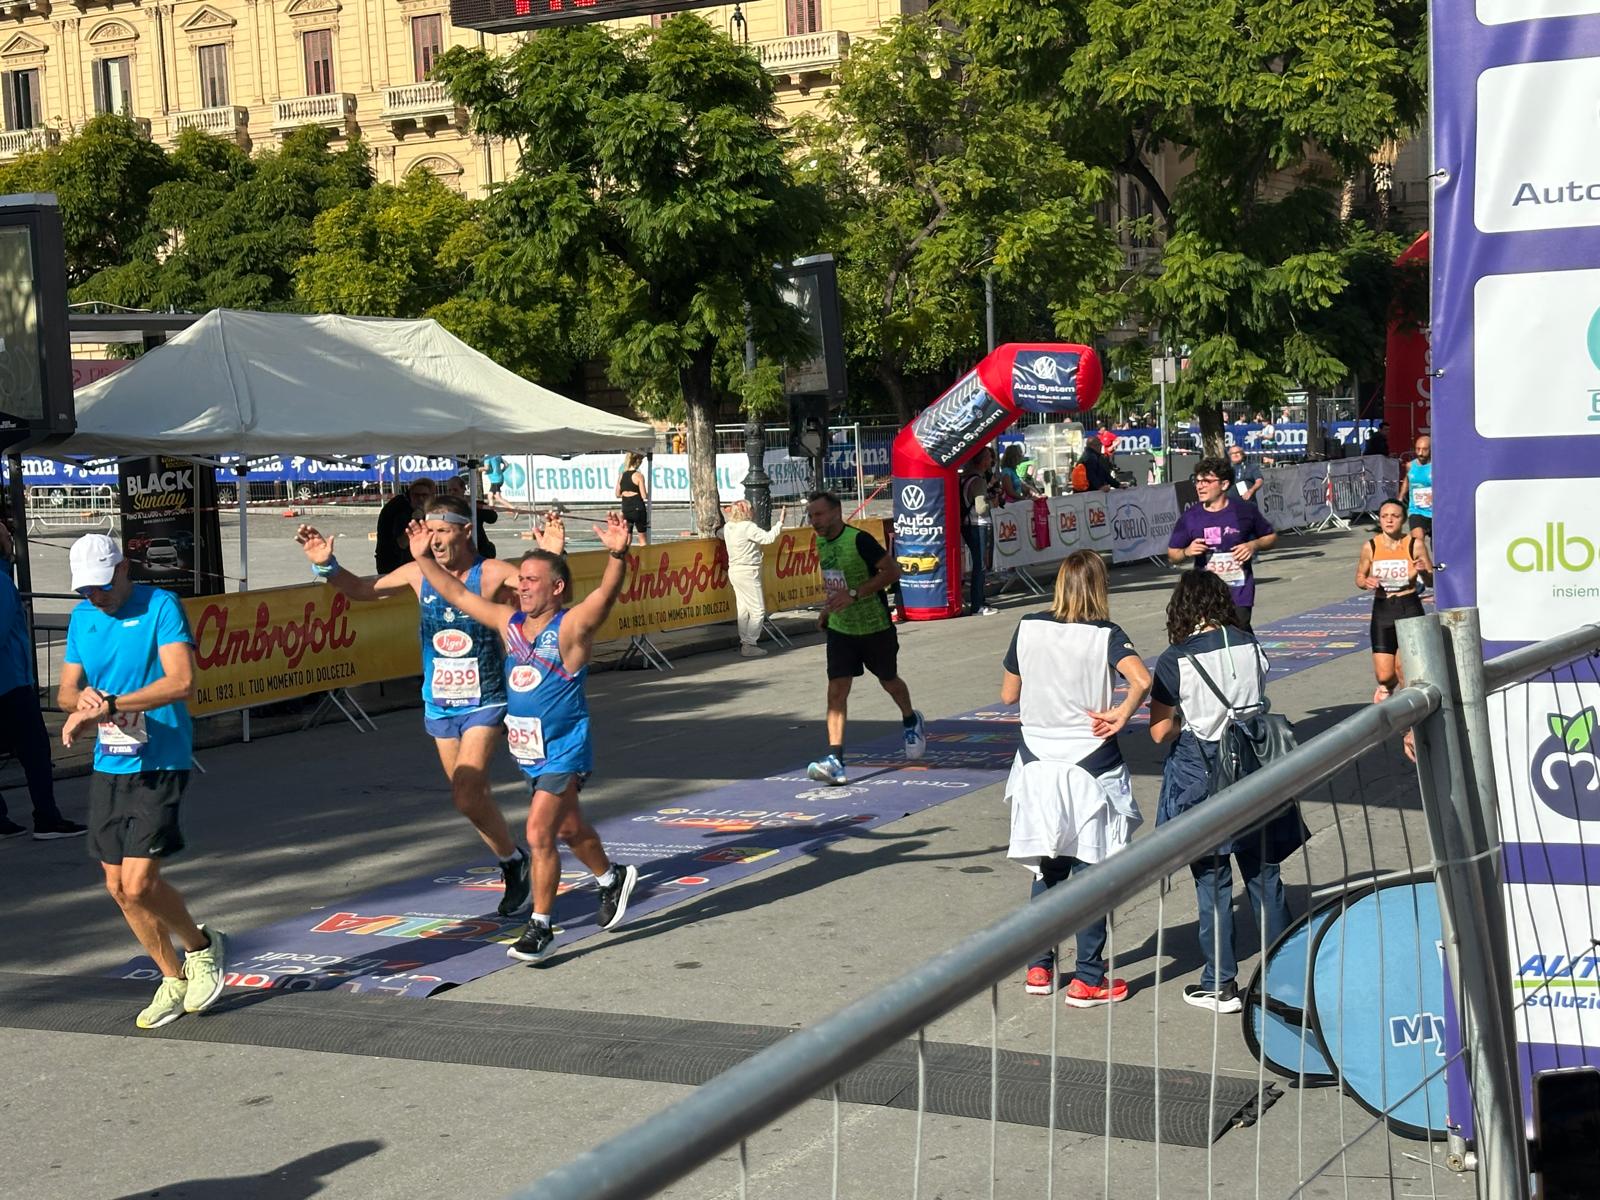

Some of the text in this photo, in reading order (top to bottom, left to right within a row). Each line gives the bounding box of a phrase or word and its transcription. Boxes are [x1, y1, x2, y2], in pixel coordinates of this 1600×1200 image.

[1014, 382, 1075, 393] Auto System
[941, 441, 966, 463] Auto
[127, 470, 194, 496] BLACK
[535, 467, 615, 490] ERBAGIL
[133, 490, 187, 511] Sunday
[893, 521, 943, 537] System
[897, 513, 934, 528] Auto
[1506, 522, 1600, 573] alb
[1375, 567, 1407, 580] 2768
[197, 688, 213, 704] DAL
[238, 680, 246, 697] IL
[248, 677, 265, 694] TUO
[267, 671, 304, 691] MOMENTO
[306, 669, 314, 684] DI
[317, 662, 356, 682] DOLCEZZA
[433, 669, 477, 686] 2939
